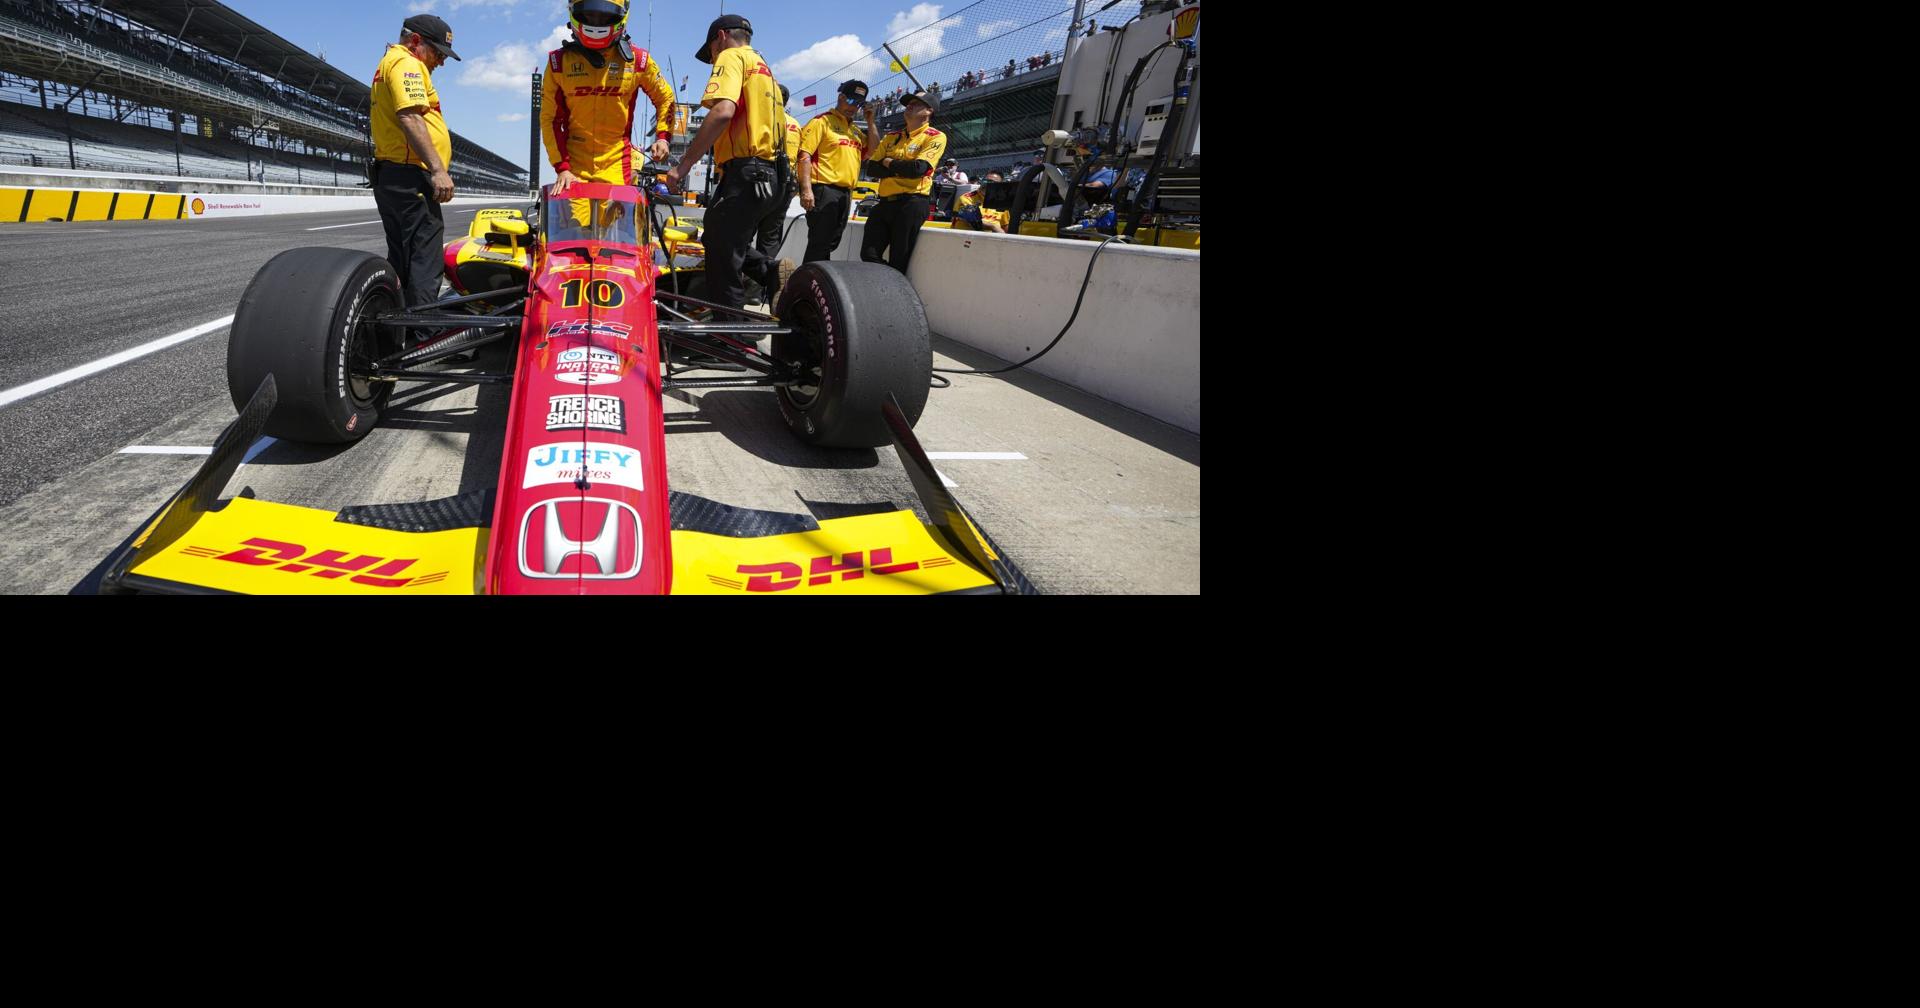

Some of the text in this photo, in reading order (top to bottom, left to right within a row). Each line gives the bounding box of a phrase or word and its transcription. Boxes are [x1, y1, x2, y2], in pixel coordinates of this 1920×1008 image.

[574, 86, 623, 97] DHL
[375, 269, 386, 278] 500
[559, 278, 625, 309] 10
[811, 279, 835, 359] Firestone
[587, 352, 615, 361] NTT
[556, 361, 620, 372] INDYCAR
[549, 397, 620, 414] TRENCH
[545, 411, 621, 426] SHORING
[534, 446, 632, 468] JIFFY
[211, 537, 419, 588] DHL
[736, 547, 919, 592] DHL
